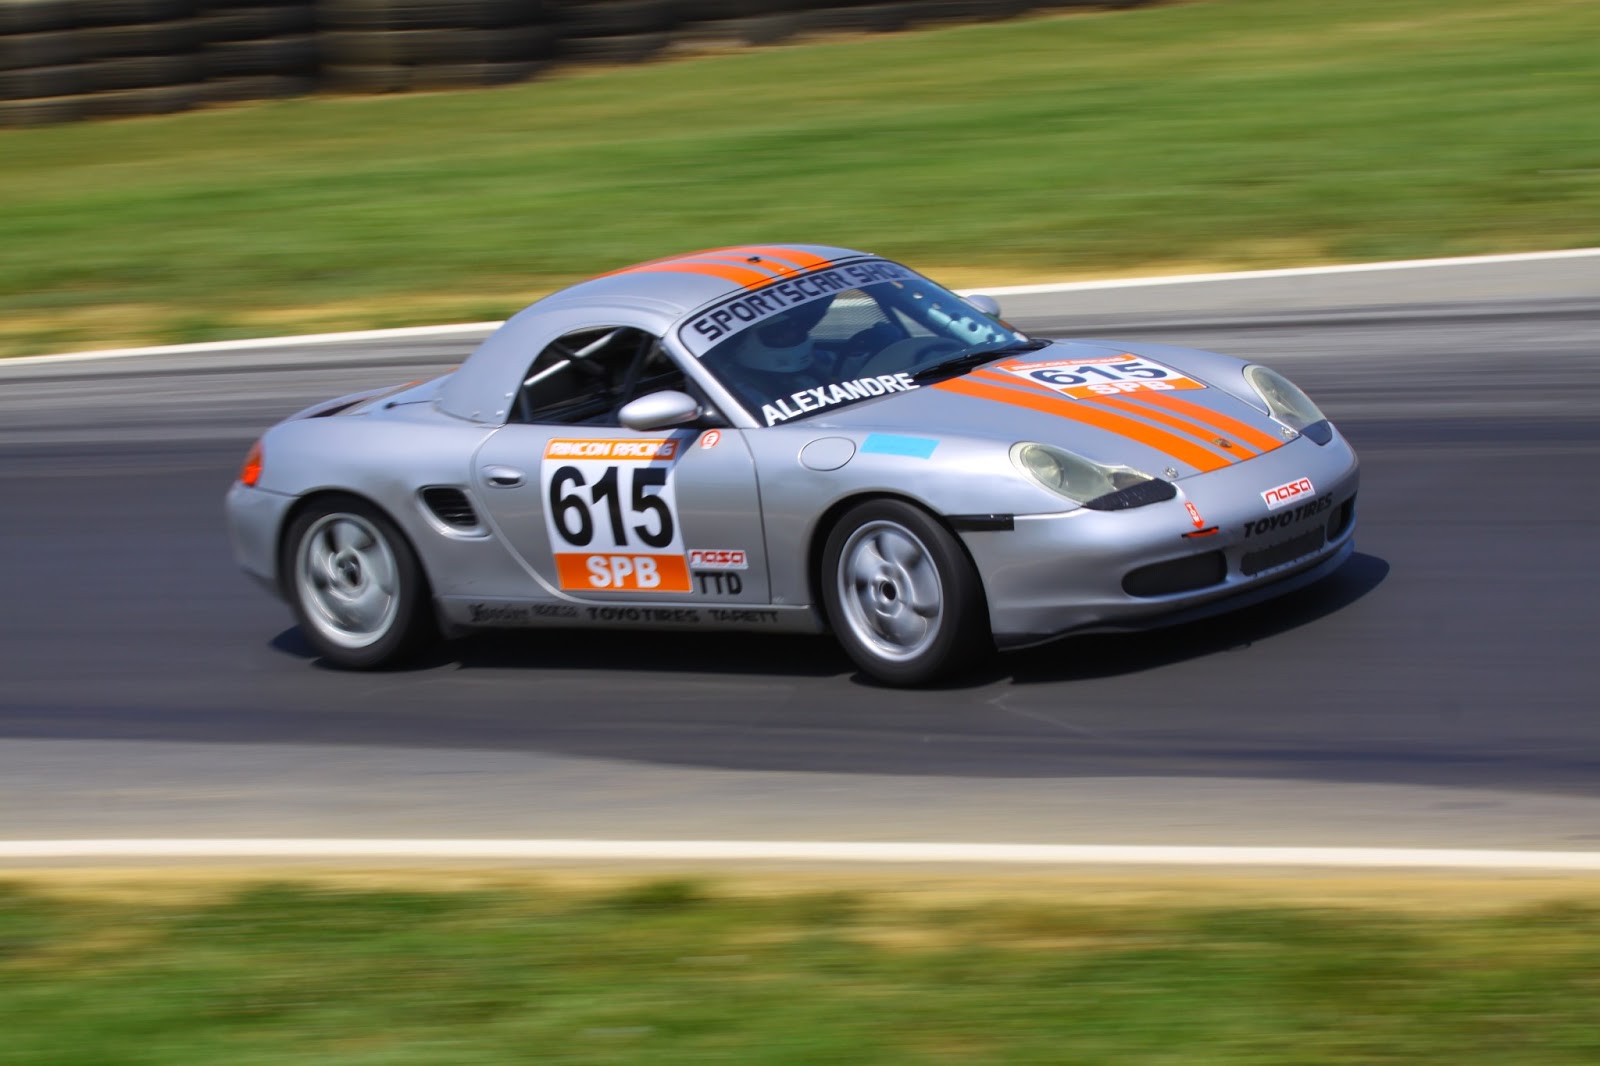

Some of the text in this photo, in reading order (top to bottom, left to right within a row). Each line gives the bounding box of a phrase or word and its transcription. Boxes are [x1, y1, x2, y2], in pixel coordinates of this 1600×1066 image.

[693, 271, 853, 342] SPORTSCAR
[1029, 362, 1168, 386] 615
[1086, 381, 1175, 395] SPB
[761, 372, 921, 428] ALEXANDRE
[612, 442, 675, 456] RACING
[550, 465, 674, 549] 615
[586, 555, 661, 589] SPB
[694, 571, 743, 595] TTD
